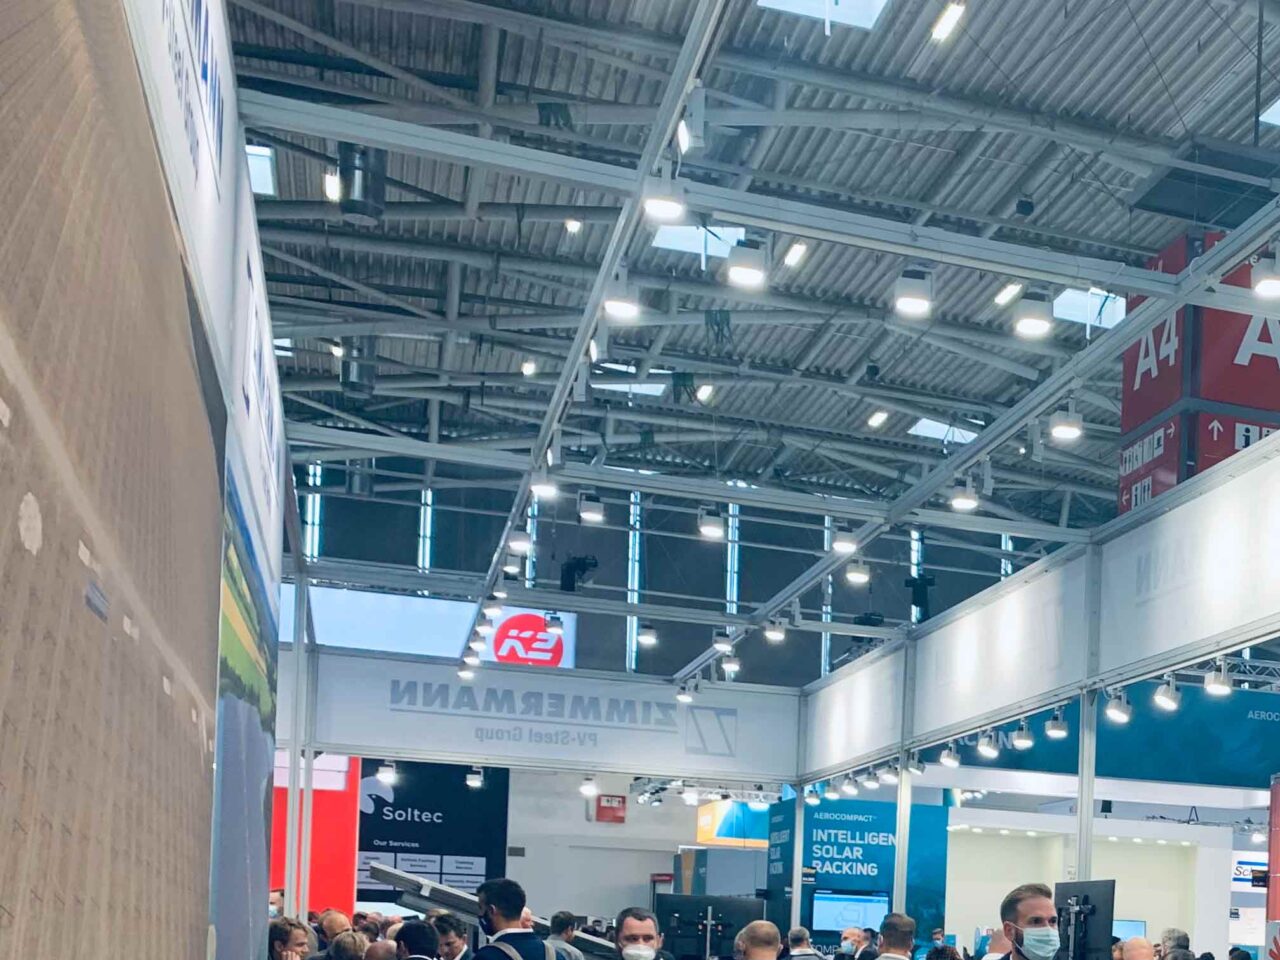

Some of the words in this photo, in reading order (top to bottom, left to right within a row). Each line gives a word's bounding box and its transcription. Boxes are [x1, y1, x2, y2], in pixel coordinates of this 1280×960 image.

[1133, 313, 1179, 391] A4
[498, 629, 561, 661] K2
[382, 806, 443, 823] Soltec
[373, 839, 387, 847] Our
[389, 840, 420, 848] Services
[812, 829, 897, 846] INTELLIGEN
[812, 844, 863, 860] SOLAR
[812, 860, 878, 876] RACKING
